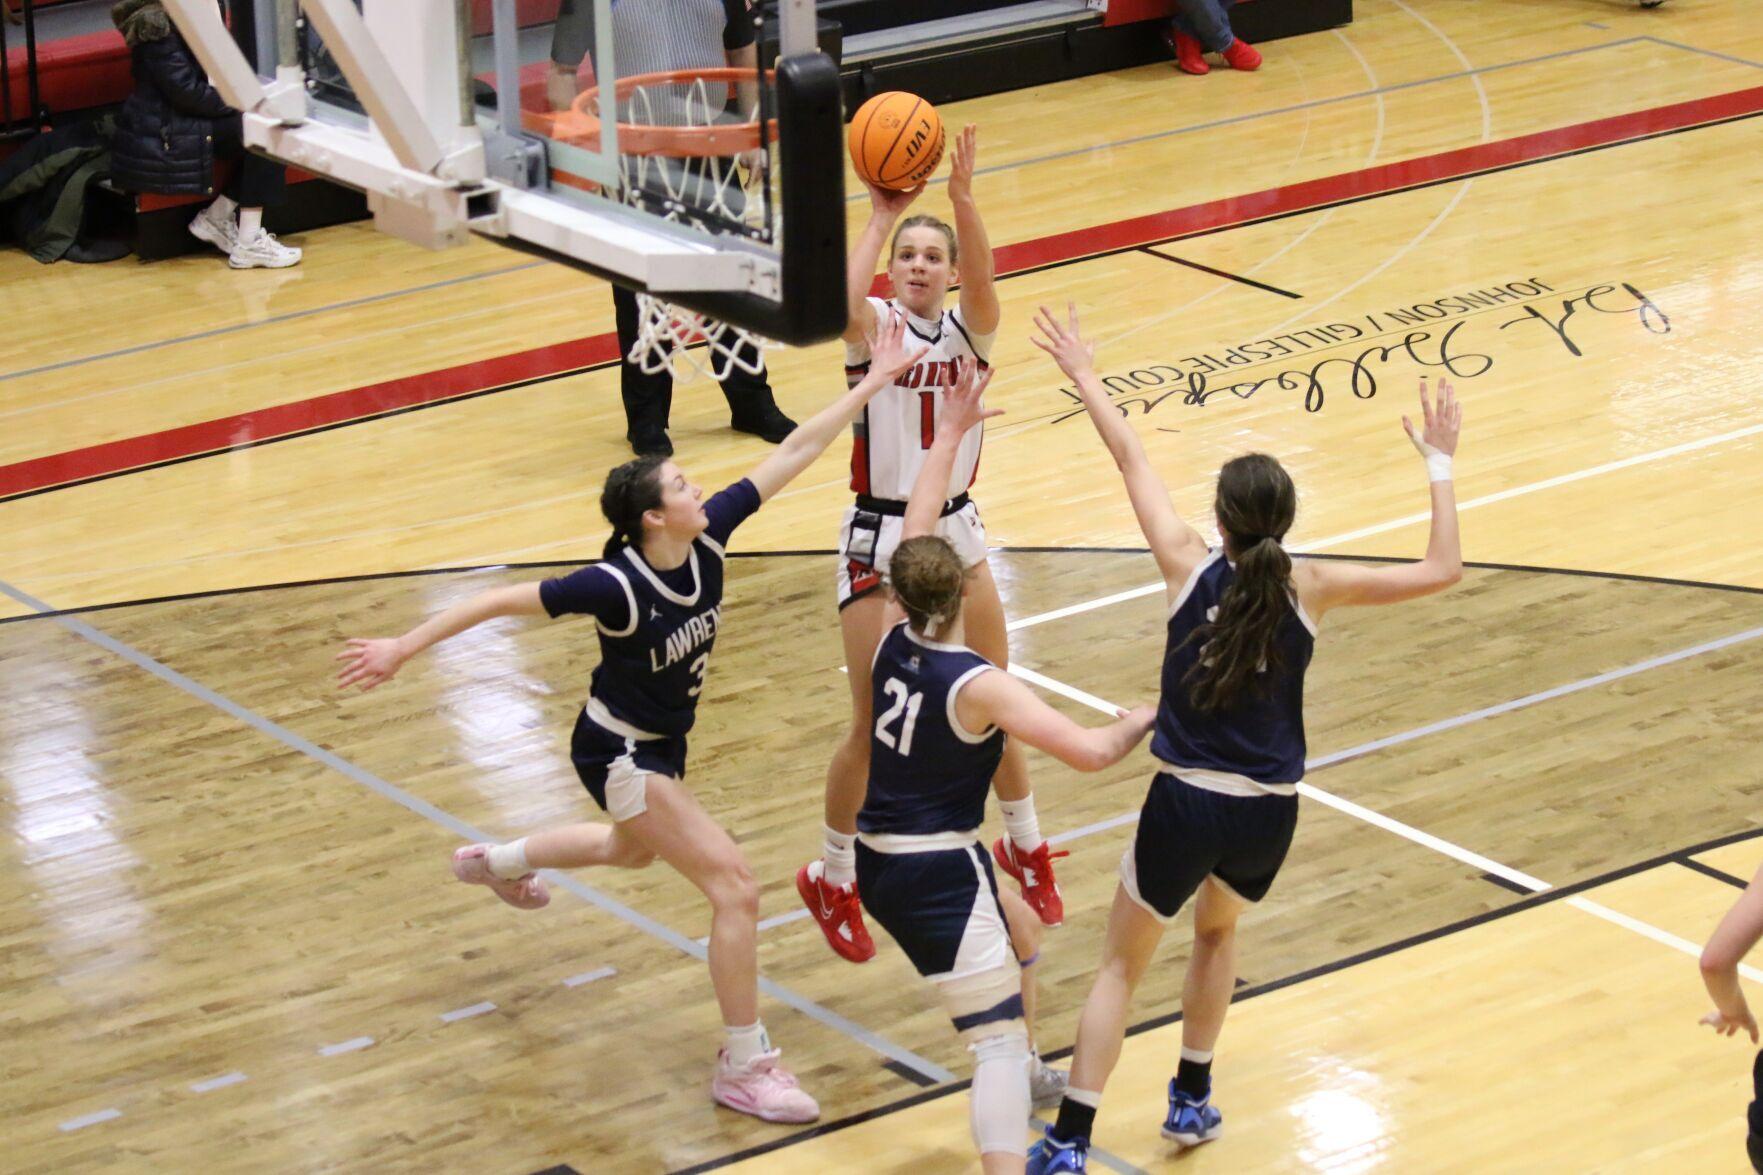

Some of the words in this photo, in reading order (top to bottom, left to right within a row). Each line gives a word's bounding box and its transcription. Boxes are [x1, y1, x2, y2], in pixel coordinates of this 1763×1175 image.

[1365, 314, 1383, 333] /
[1384, 276, 1555, 326] JOHNSON
[1178, 323, 1363, 375] GILLESPIE
[1058, 365, 1185, 406] COUT
[687, 652, 710, 697] 3
[875, 676, 924, 757] 21
